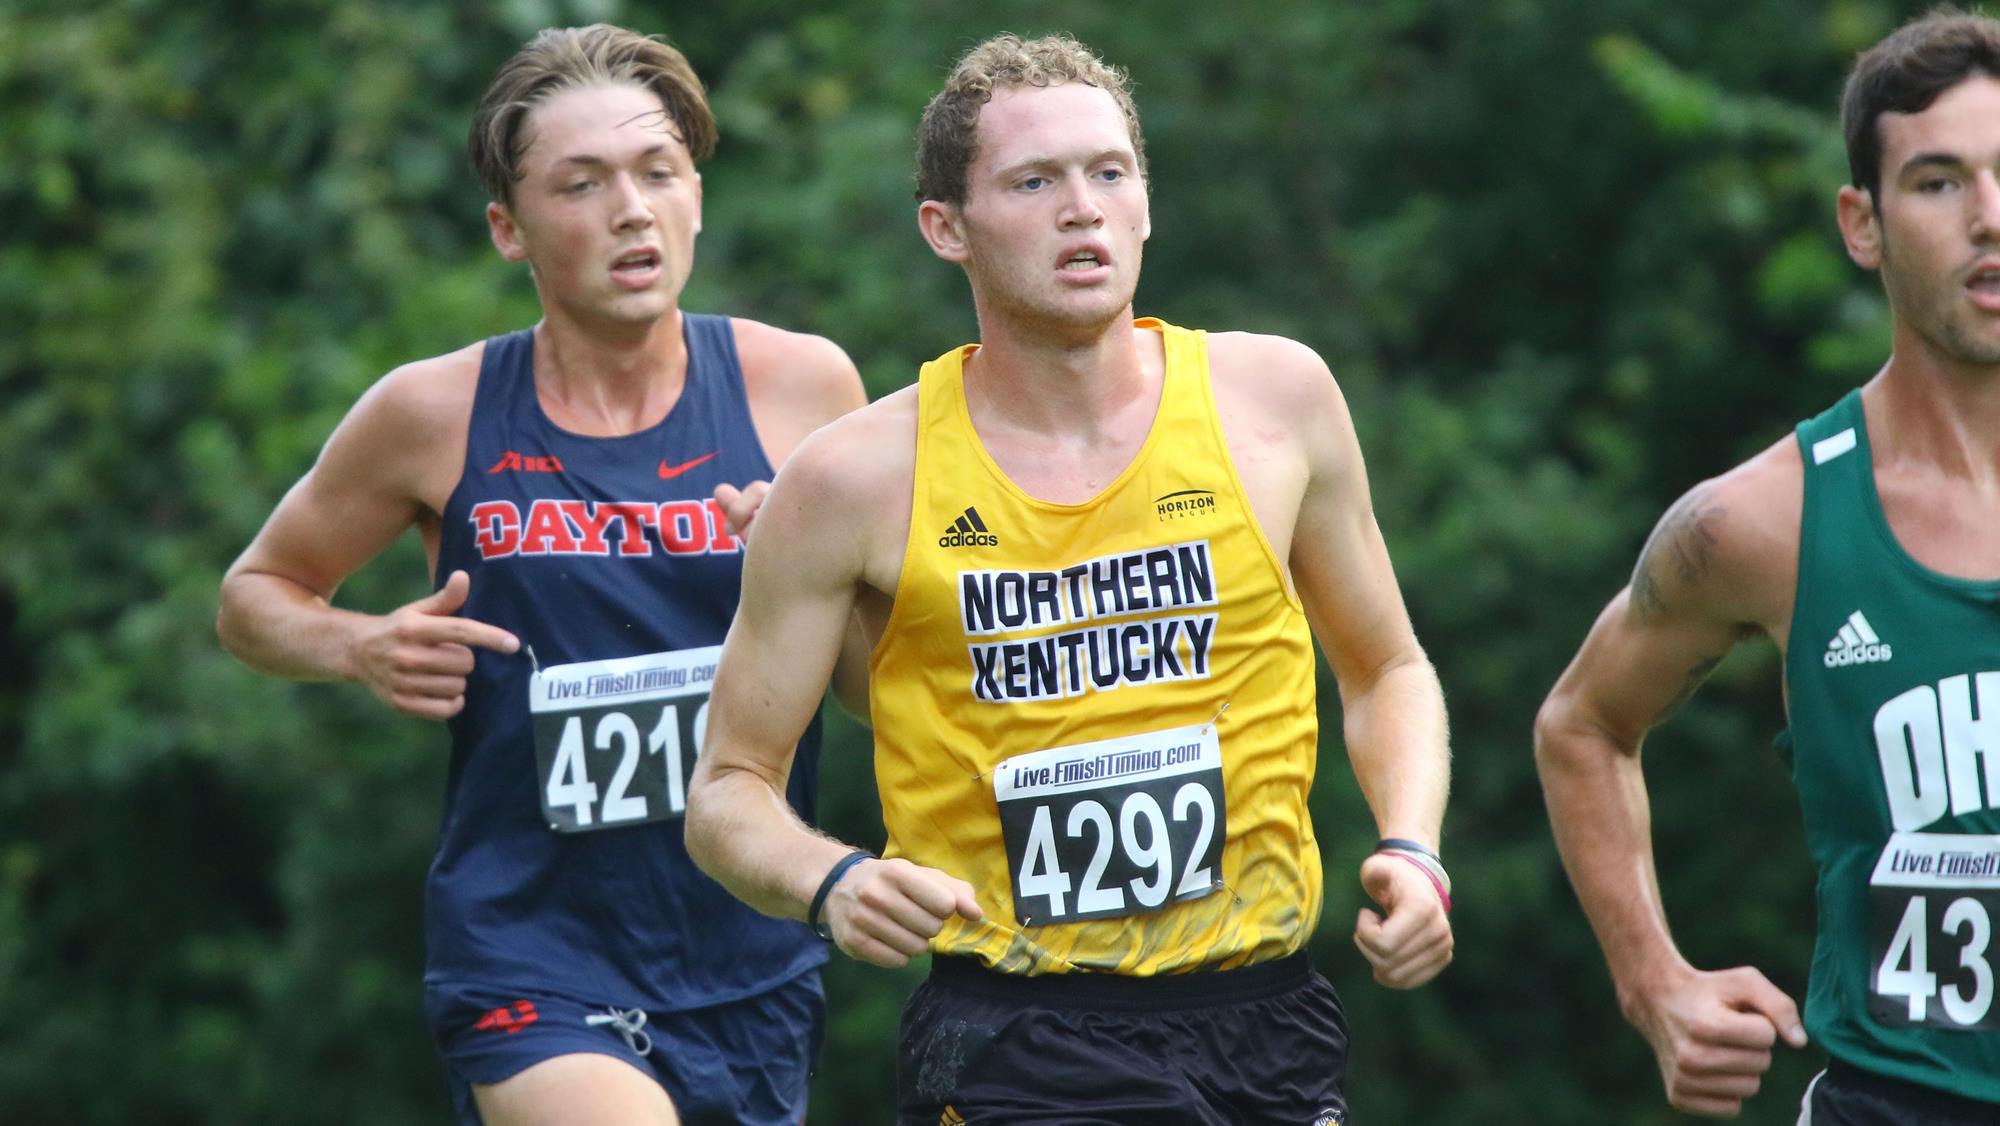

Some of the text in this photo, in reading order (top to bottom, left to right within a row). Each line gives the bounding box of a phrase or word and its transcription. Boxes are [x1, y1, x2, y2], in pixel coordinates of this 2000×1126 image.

[1157, 496, 1215, 515] HORIZON
[1159, 507, 1216, 522] LEAGUE
[939, 531, 998, 548] adidas
[960, 541, 1217, 634] NORTHERN
[970, 614, 1217, 702] KENTUCKY
[1824, 644, 1892, 668] adidas
[1013, 742, 1201, 789] Live.FinishTiming.com
[1874, 671, 2000, 833] OH
[1019, 782, 1215, 917] 4292
[1891, 849, 2000, 877] Live.Finish
[1877, 896, 1994, 1026] 43
